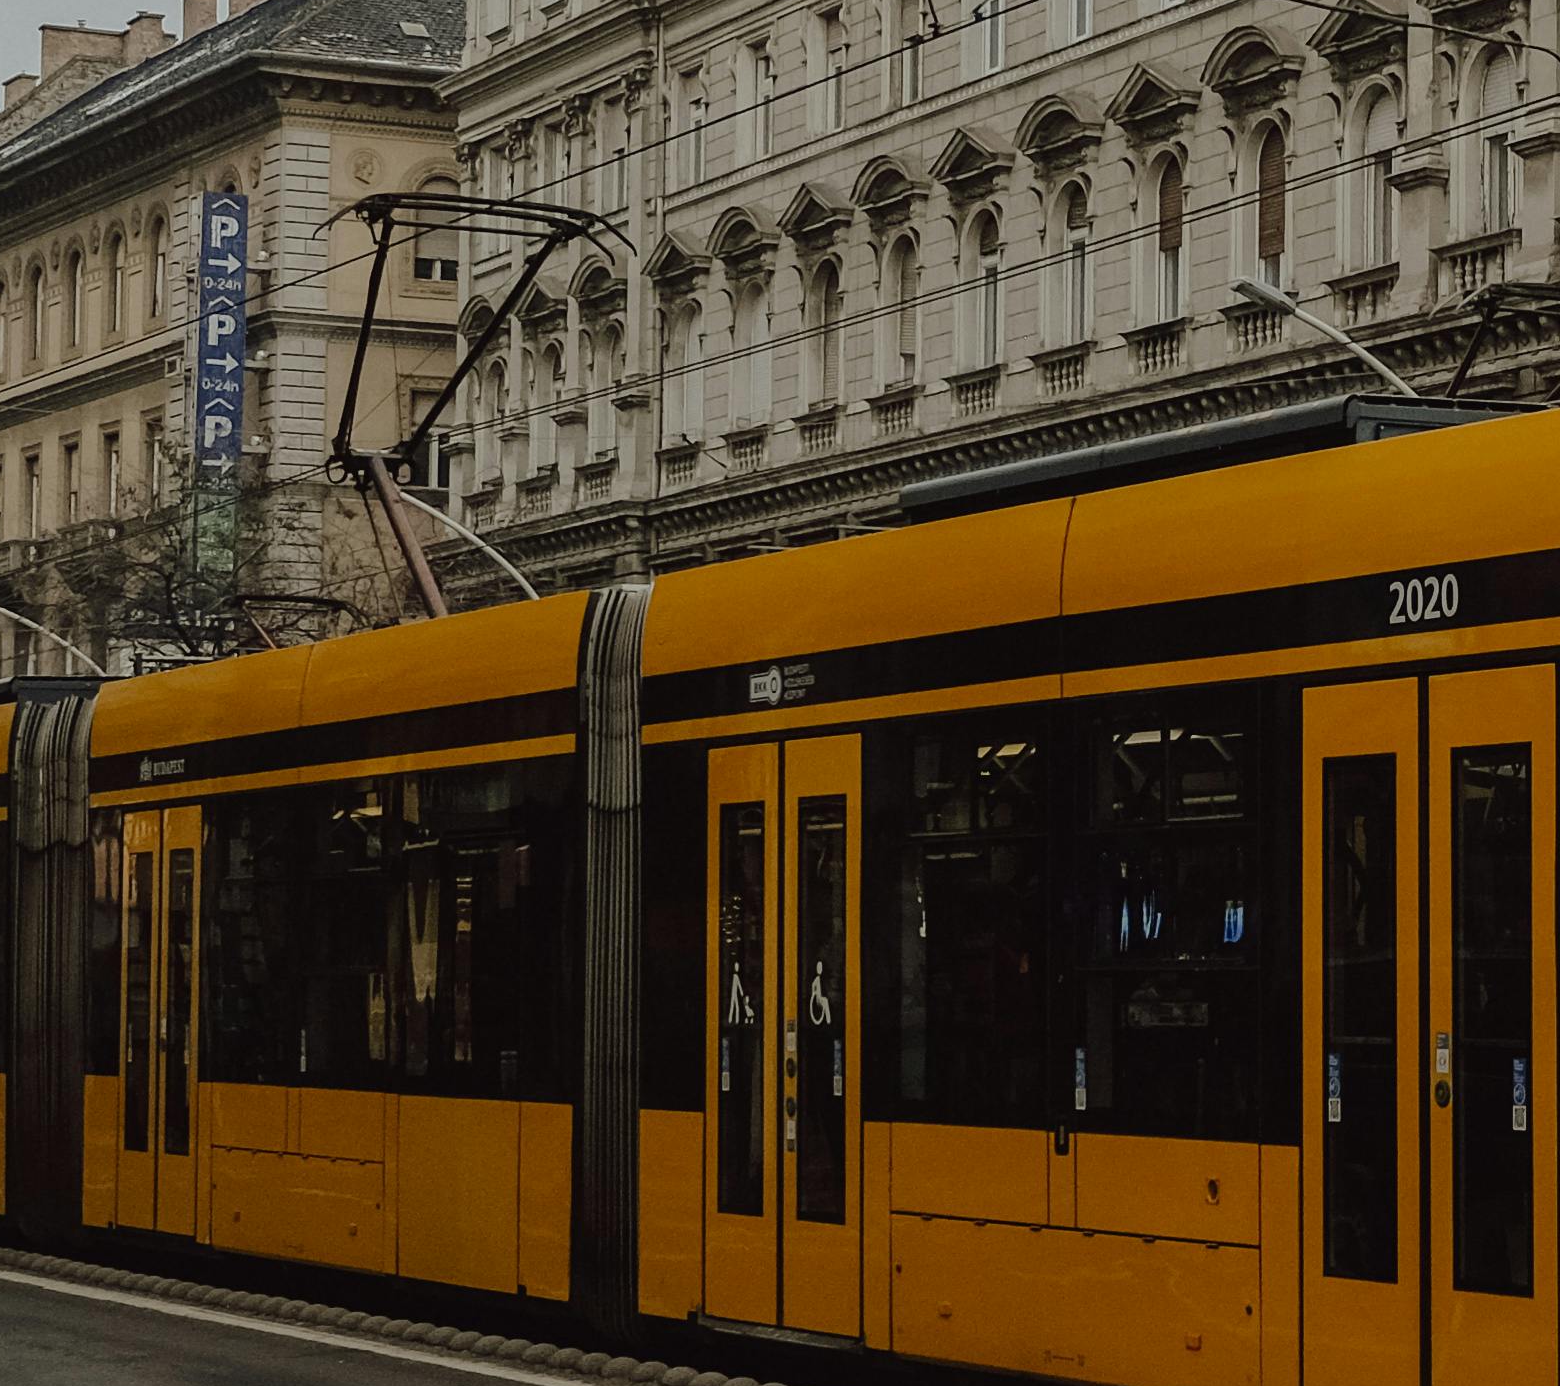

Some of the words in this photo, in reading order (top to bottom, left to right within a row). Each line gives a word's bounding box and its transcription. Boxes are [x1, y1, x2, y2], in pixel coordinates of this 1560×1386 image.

[210, 215, 240, 250] P
[203, 276, 242, 292] 0-24h
[206, 313, 237, 347] P
[202, 377, 240, 392] 0-24h
[203, 415, 233, 449] P
[1388, 573, 1460, 625] 2020
